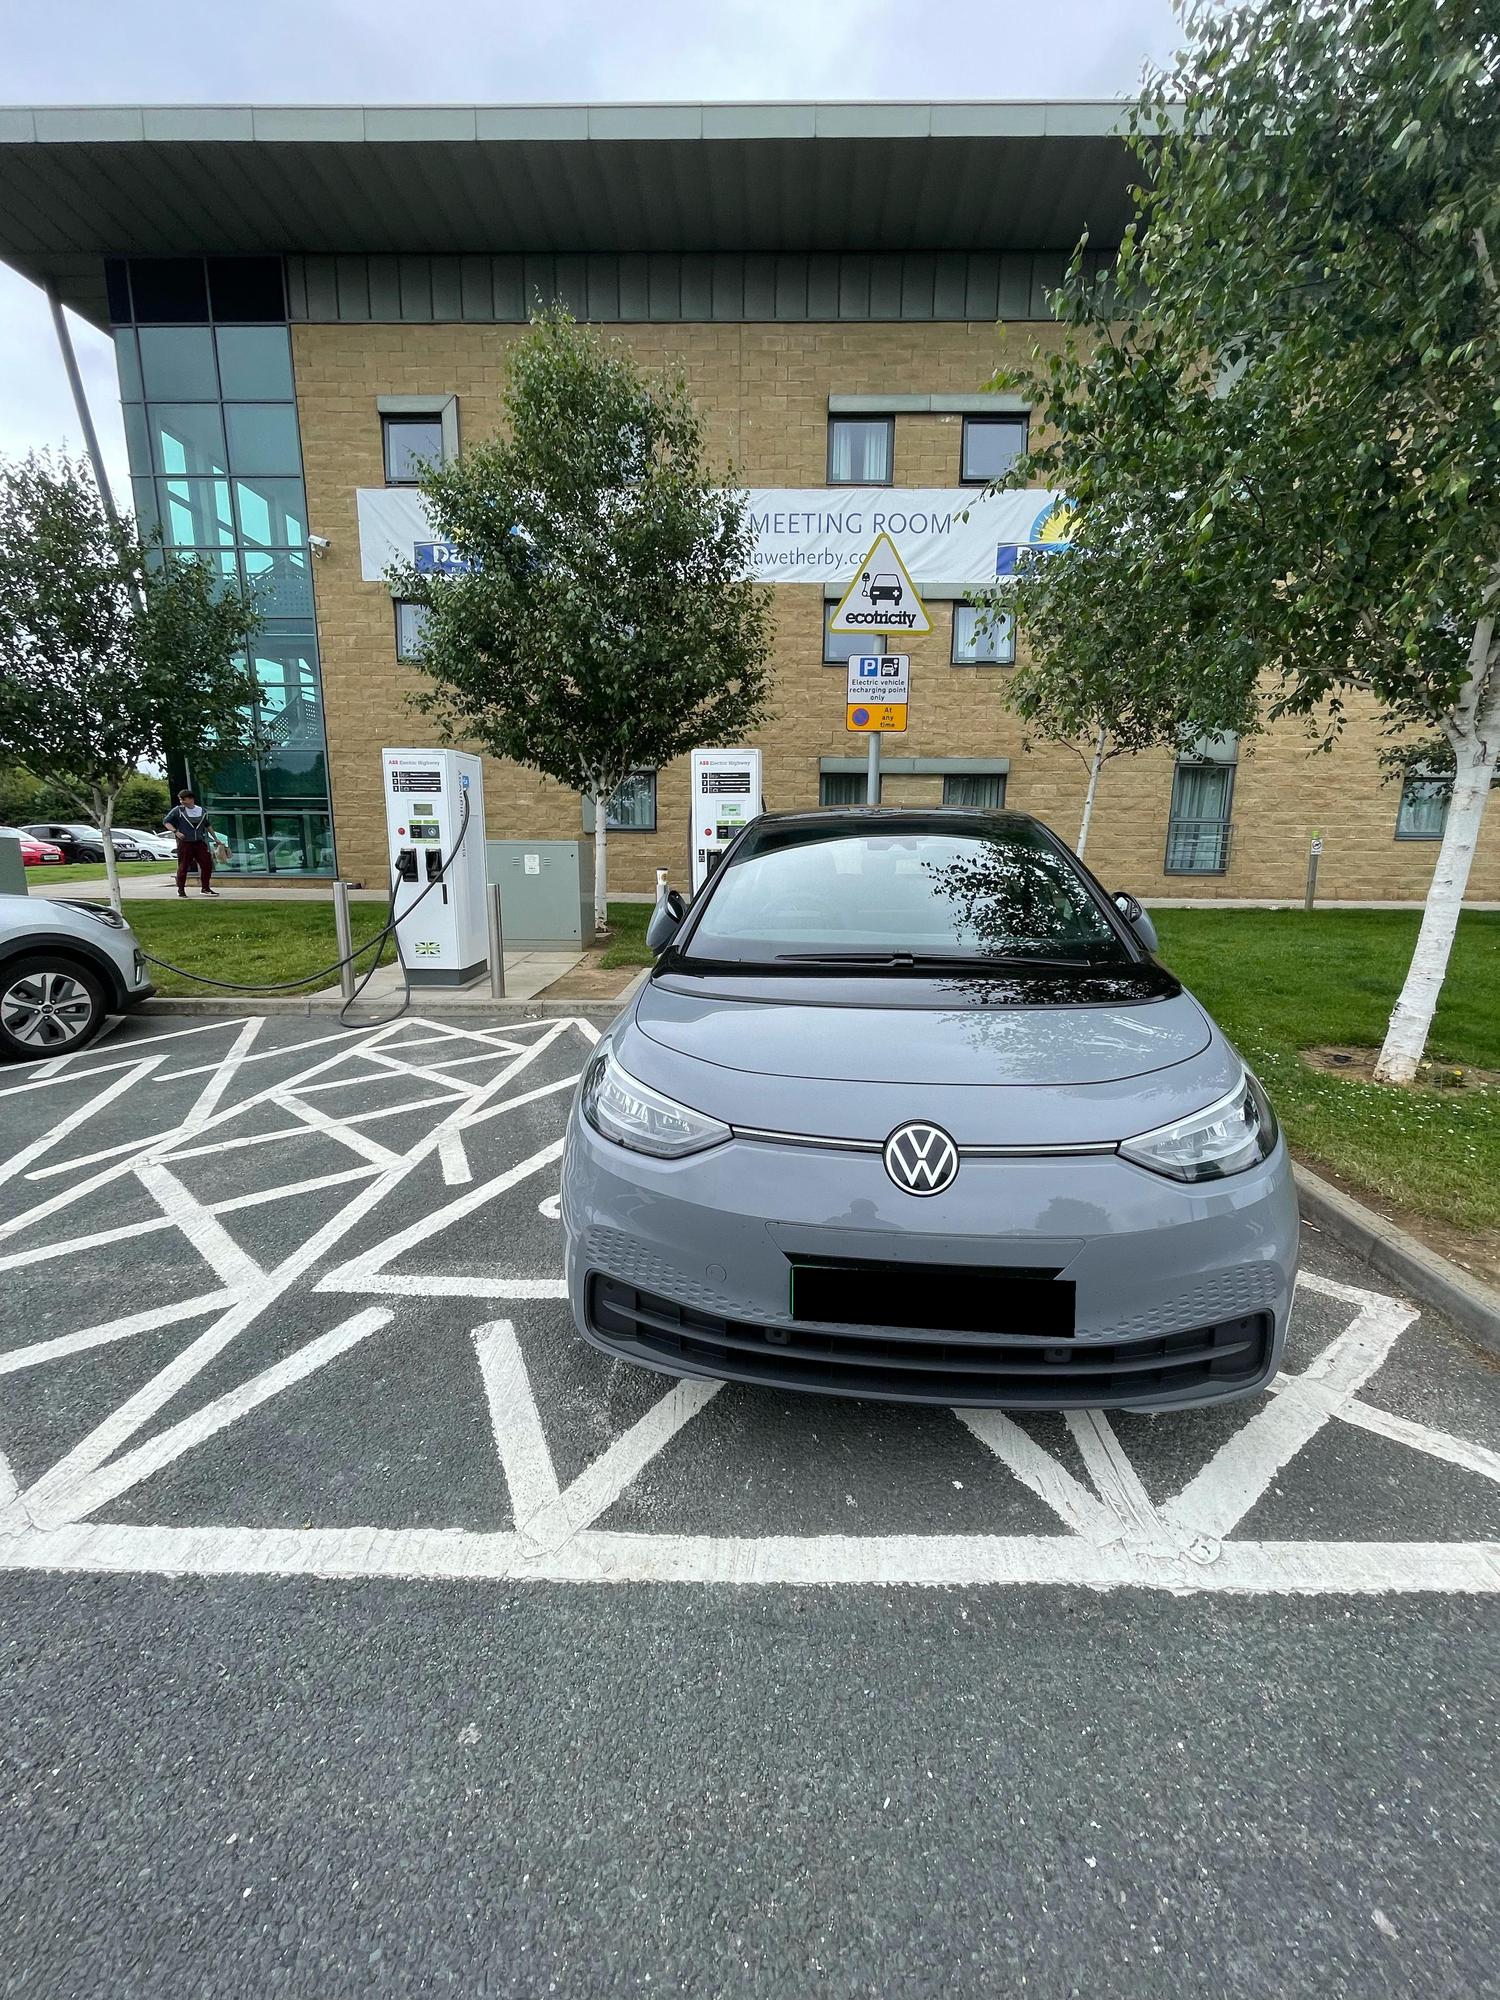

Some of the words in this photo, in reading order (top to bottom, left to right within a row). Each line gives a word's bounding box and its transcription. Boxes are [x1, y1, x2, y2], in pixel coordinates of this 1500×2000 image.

[750, 513, 862, 534] MEETING
[873, 513, 951, 534] ROOM
[845, 610, 917, 628] ecotricity
[864, 660, 876, 676] P
[849, 686, 887, 694] recharging
[888, 686, 906, 694] point
[870, 694, 885, 702] only
